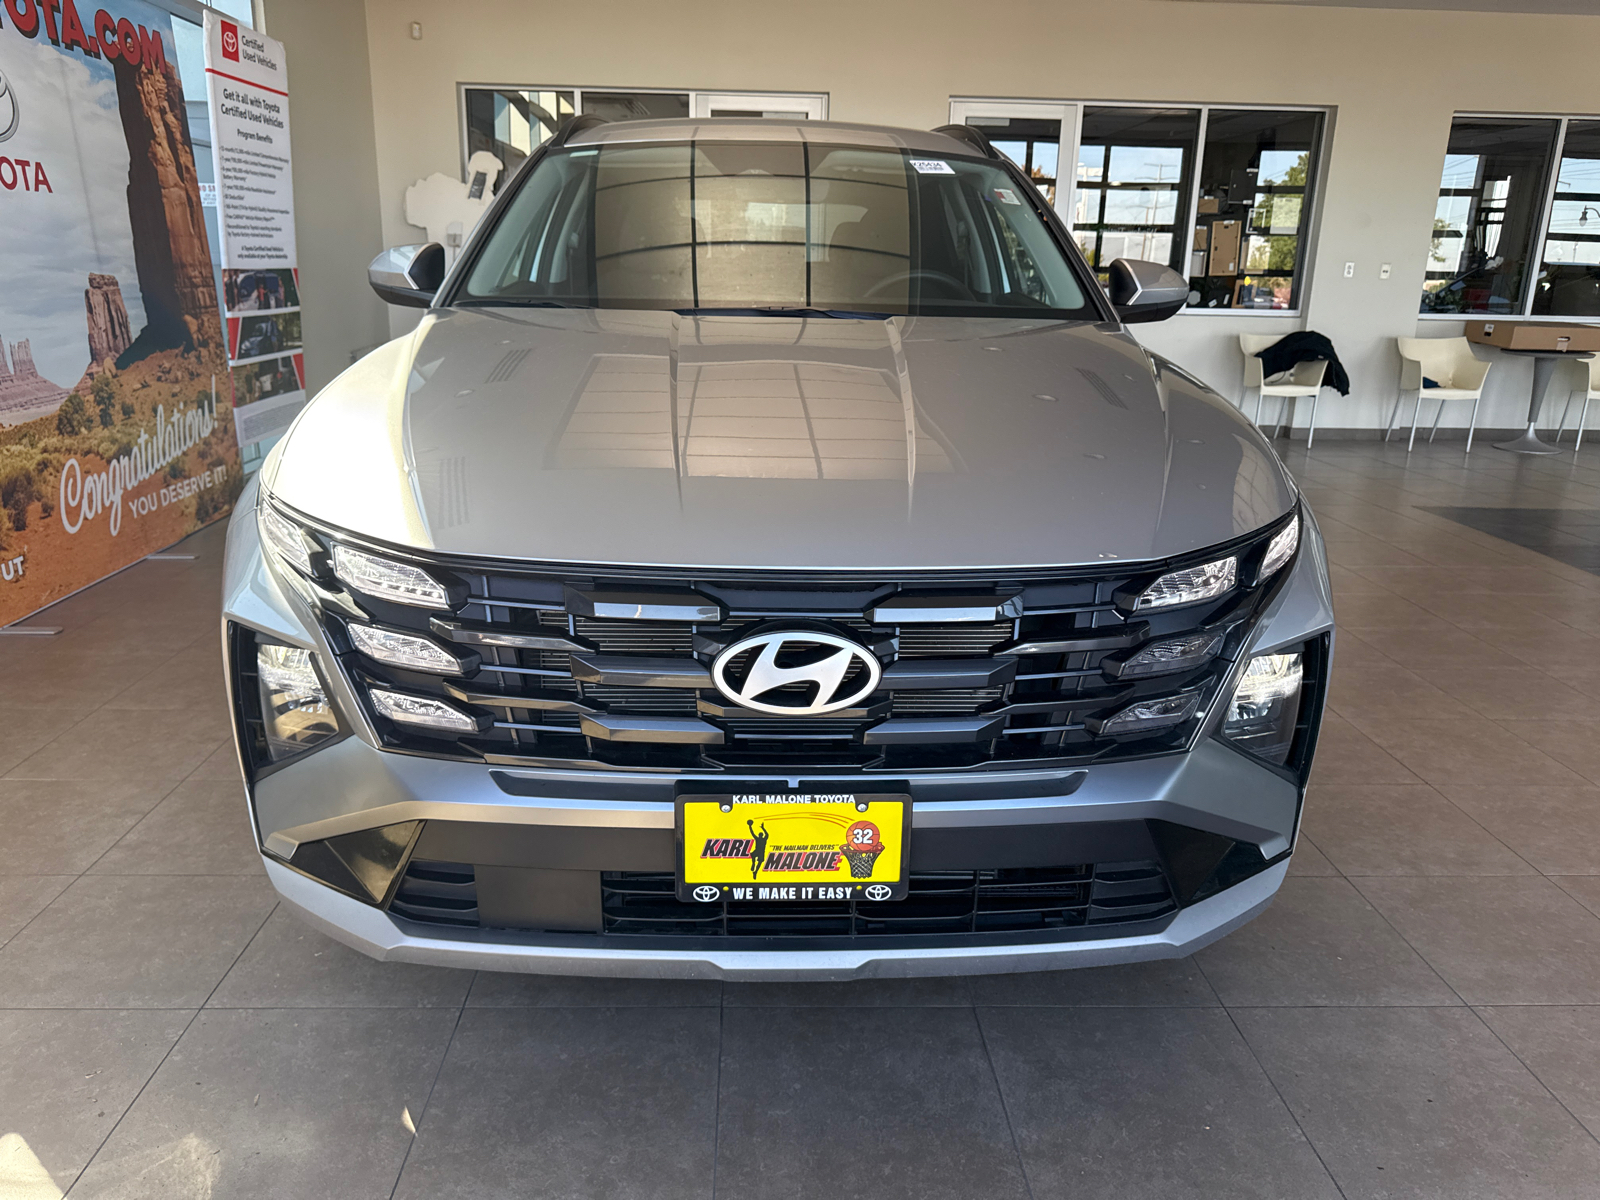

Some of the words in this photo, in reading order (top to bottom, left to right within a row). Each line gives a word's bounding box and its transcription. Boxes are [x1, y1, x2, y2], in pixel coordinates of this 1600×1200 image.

[0, 0, 167, 75] OTA.COM
[241, 35, 265, 53] Certified
[242, 49, 257, 63] Used
[256, 54, 278, 71] Vehicles
[223, 88, 235, 101] Get
[235, 91, 241, 103] it
[241, 94, 249, 106] all
[249, 97, 263, 108] with
[262, 99, 280, 114] Toyota
[221, 104, 247, 120] Certified
[247, 110, 263, 123] Used
[262, 115, 284, 129] Vehicles
[237, 128, 256, 141] Program
[256, 131, 273, 144] Benefits
[60, 375, 219, 537] Congratulations!
[129, 492, 158, 519] YOU
[160, 472, 213, 507] DESERVE
[214, 464, 228, 484] IT!
[1, 556, 24, 581] UT
[732, 794, 763, 804] KARL
[765, 794, 812, 804] MALONE
[814, 794, 856, 804] TOYOTA
[852, 828, 874, 844] 32
[700, 838, 755, 859] KARL
[762, 850, 843, 872] MALONE
[732, 887, 753, 900] WE
[758, 887, 797, 900] MAKE
[801, 887, 814, 900] IT
[821, 887, 853, 900] EASY
